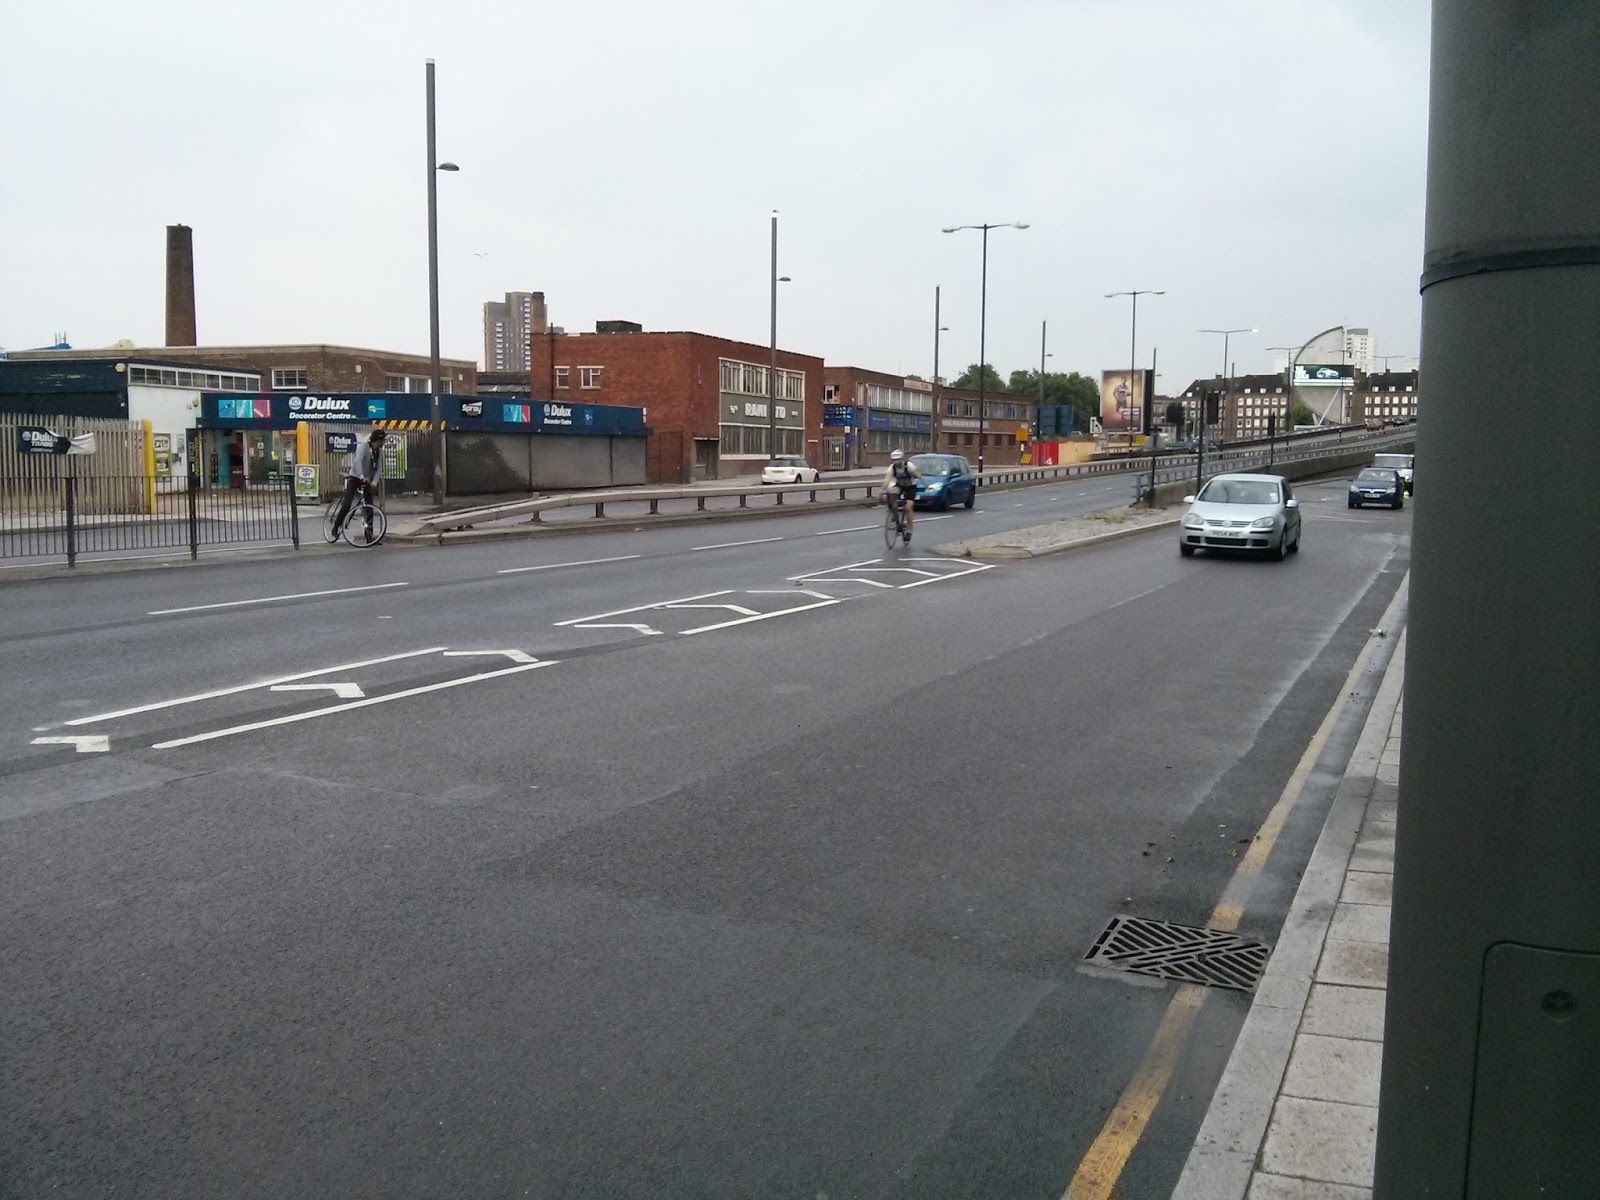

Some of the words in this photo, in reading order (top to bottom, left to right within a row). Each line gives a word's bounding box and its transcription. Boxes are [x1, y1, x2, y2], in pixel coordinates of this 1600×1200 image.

[304, 396, 350, 410] Dulux
[461, 403, 482, 415] Spray
[551, 404, 571, 417] Dulux
[334, 436, 352, 445] Dulux
